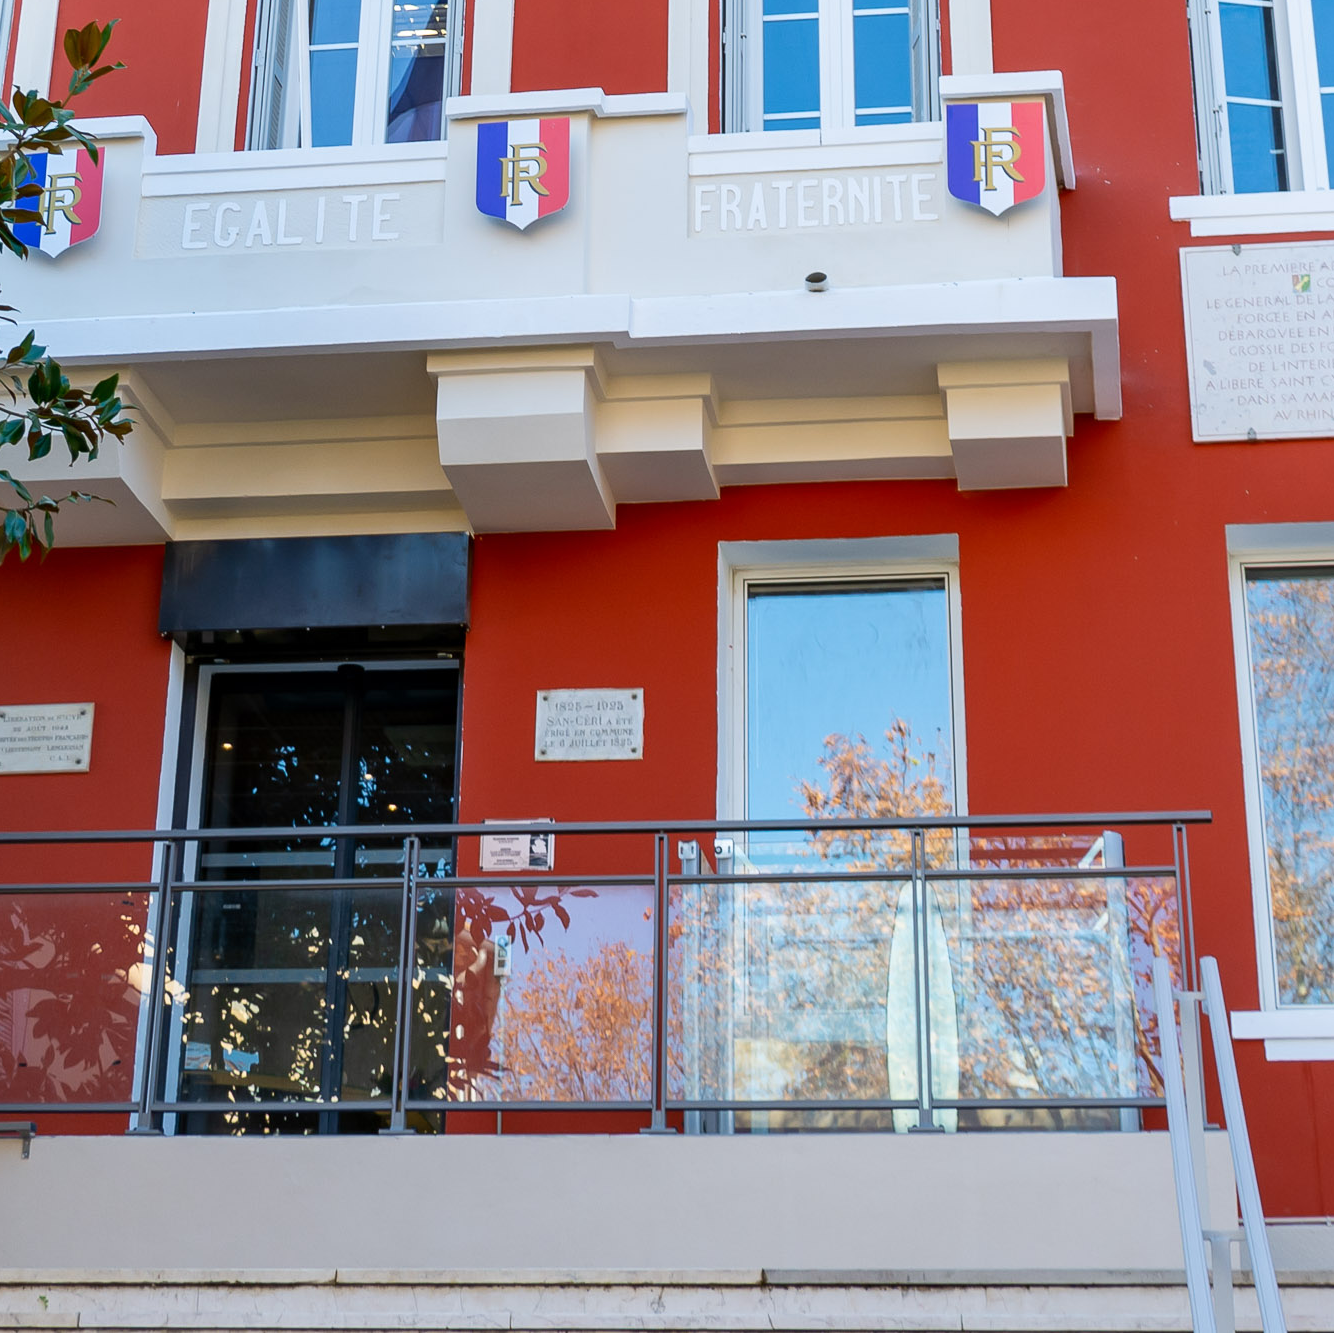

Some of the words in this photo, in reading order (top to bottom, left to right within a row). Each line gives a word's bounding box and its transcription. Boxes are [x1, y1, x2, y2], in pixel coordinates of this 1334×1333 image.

[694, 173, 940, 233] FRATERNITE
[181, 192, 401, 250] EGALITE
[1222, 265, 1241, 277] LA
[1206, 299, 1220, 310] LE
[1295, 294, 1315, 305] DE
[1296, 310, 1316, 322] EN
[1308, 326, 1330, 337] EN
[1229, 344, 1285, 357] GROSSIE
[1290, 342, 1316, 354] DES
[1248, 361, 1267, 373] DE
[1205, 380, 1216, 391] A
[1270, 376, 1315, 388] SAINT
[1237, 394, 1276, 406] DANS
[1281, 393, 1298, 404] SA
[1297, 409, 1334, 420] RHIN
